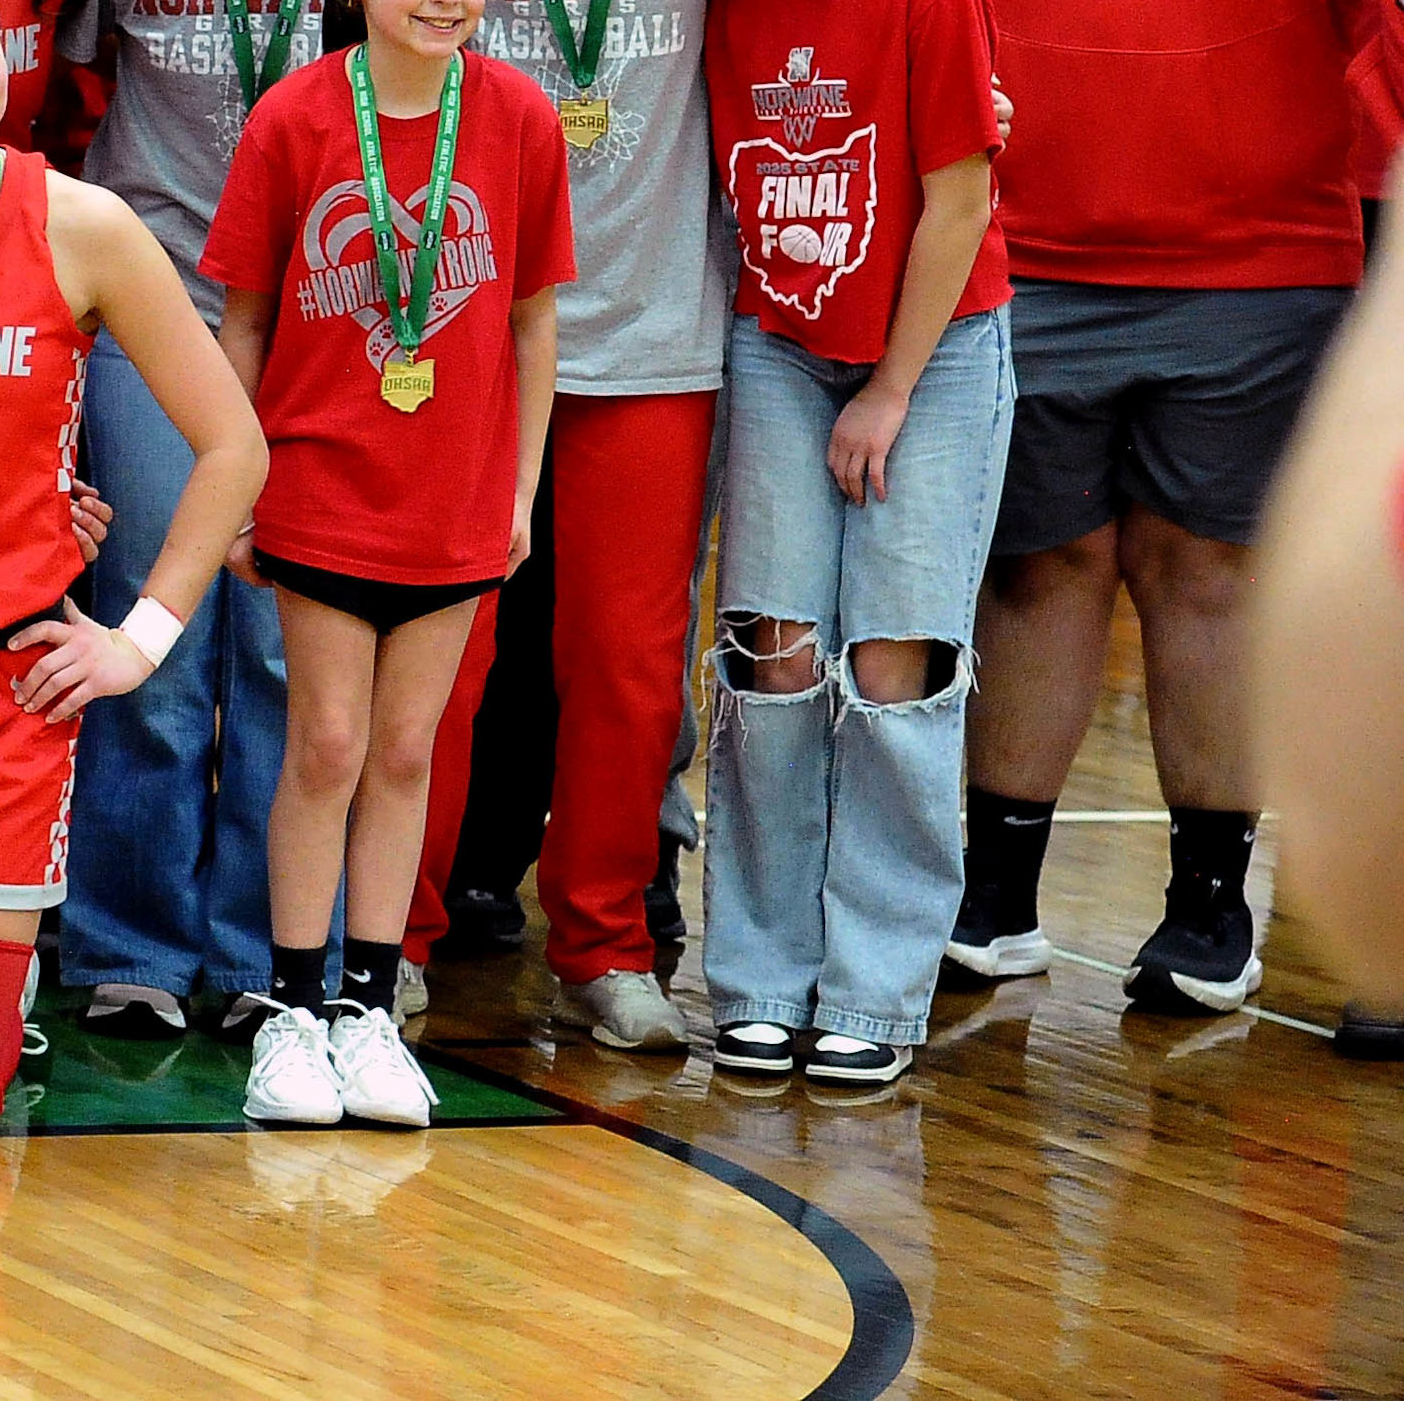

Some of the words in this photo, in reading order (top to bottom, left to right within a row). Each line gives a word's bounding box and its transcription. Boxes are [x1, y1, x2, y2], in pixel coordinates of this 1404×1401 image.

[752, 85, 848, 111] NORWAYNE
[795, 159, 860, 174] STATE
[757, 172, 850, 220] FINAL
[384, 376, 432, 392] OHSAA
